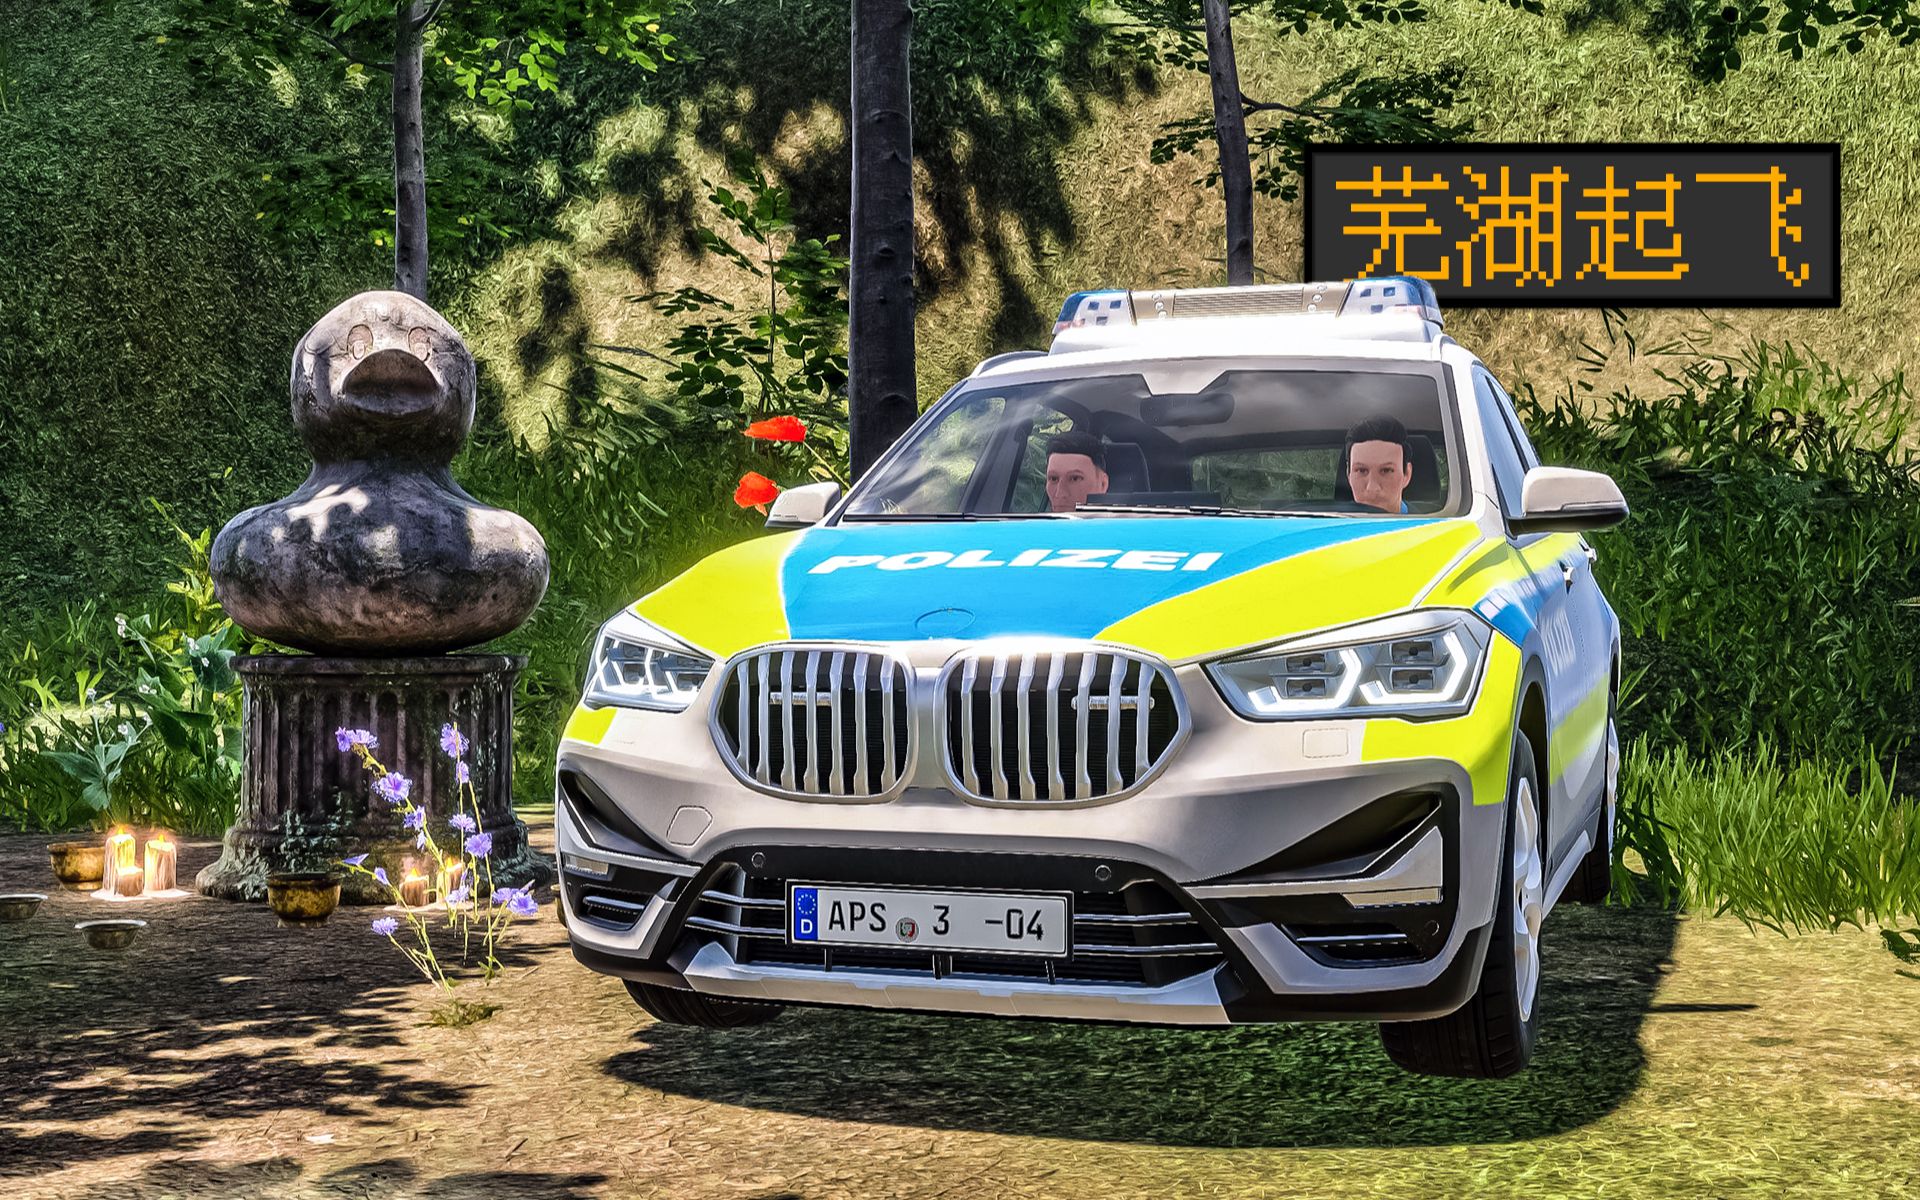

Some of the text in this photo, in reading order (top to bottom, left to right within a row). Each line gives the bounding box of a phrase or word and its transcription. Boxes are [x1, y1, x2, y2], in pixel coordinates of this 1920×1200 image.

[1336, 166, 1810, 287] 芜湖起飞
[808, 549, 1223, 574] POLIZEI
[801, 918, 812, 934] D
[828, 900, 887, 932] APS
[932, 905, 950, 936] 3
